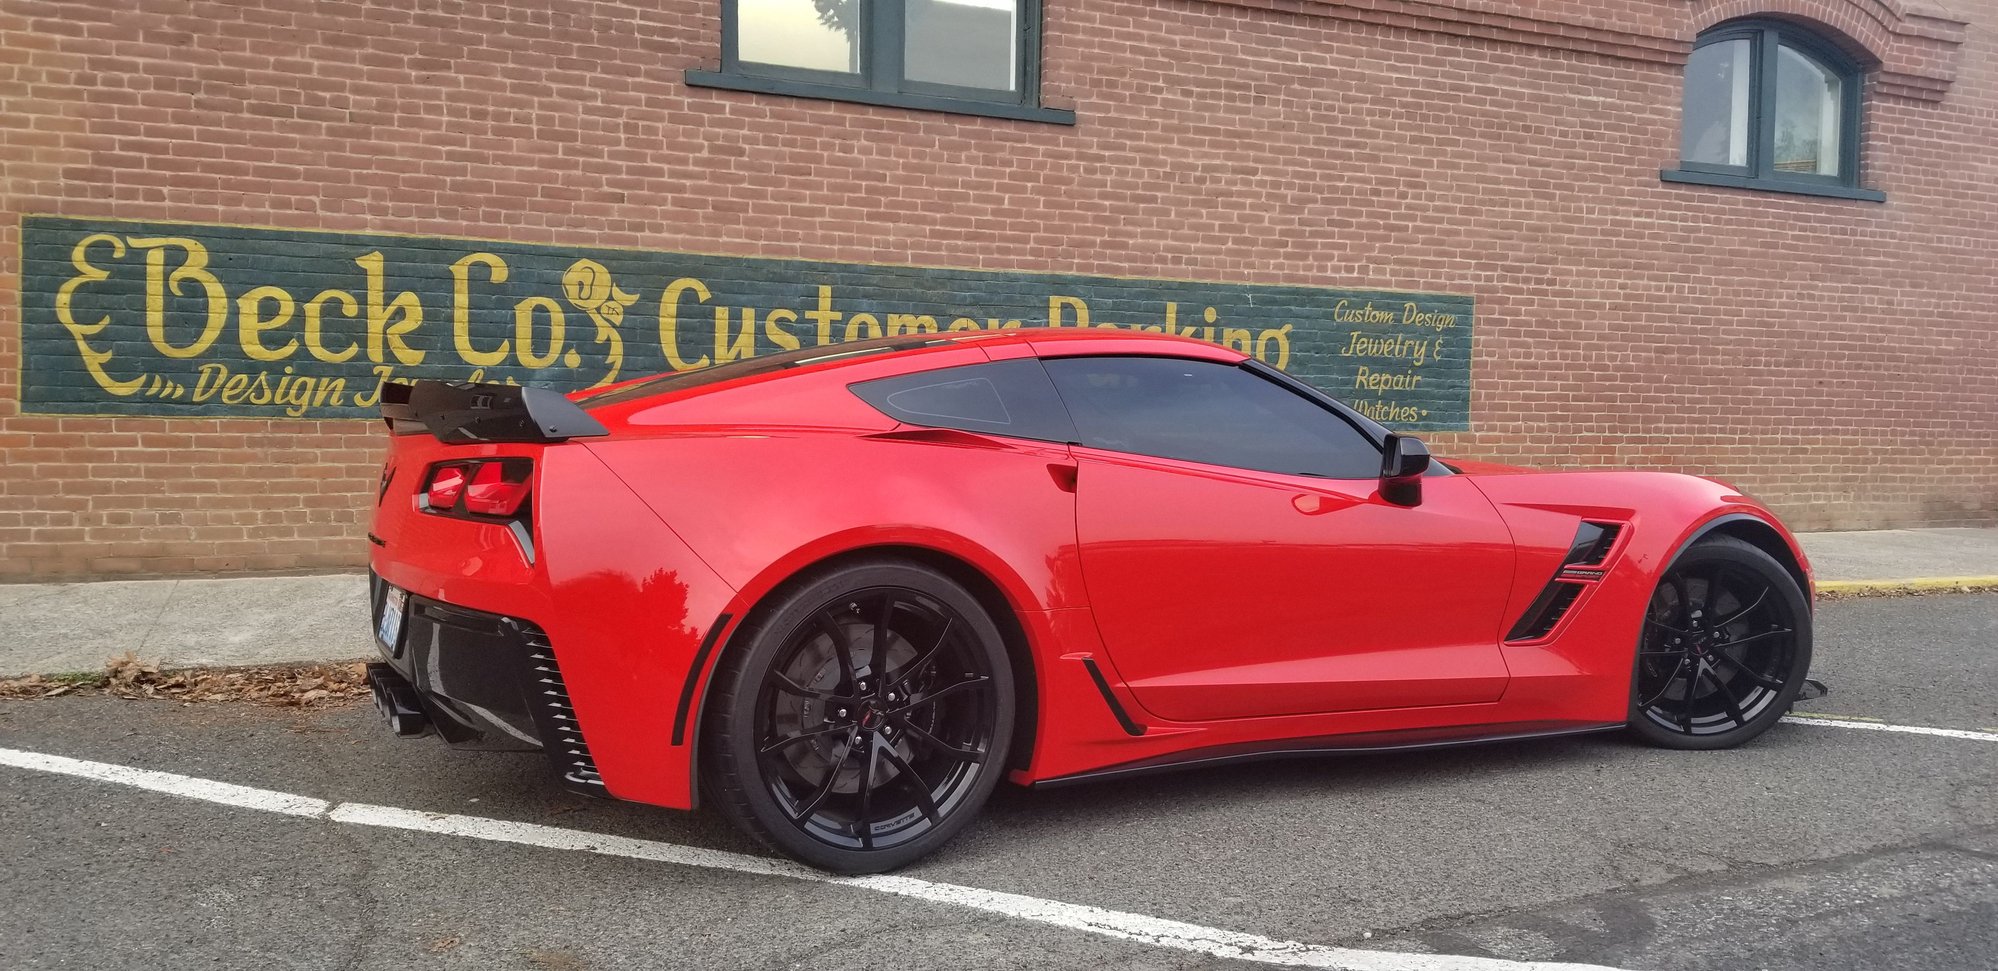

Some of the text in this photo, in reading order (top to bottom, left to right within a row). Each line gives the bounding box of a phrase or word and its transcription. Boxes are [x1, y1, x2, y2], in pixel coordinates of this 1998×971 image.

[126, 236, 426, 366] Beck
[448, 252, 582, 369] Co.
[1334, 300, 1457, 332] Custom Design
[1341, 331, 1428, 366] Jewelry
[192, 363, 344, 416] Design
[1355, 366, 1423, 395] Repair
